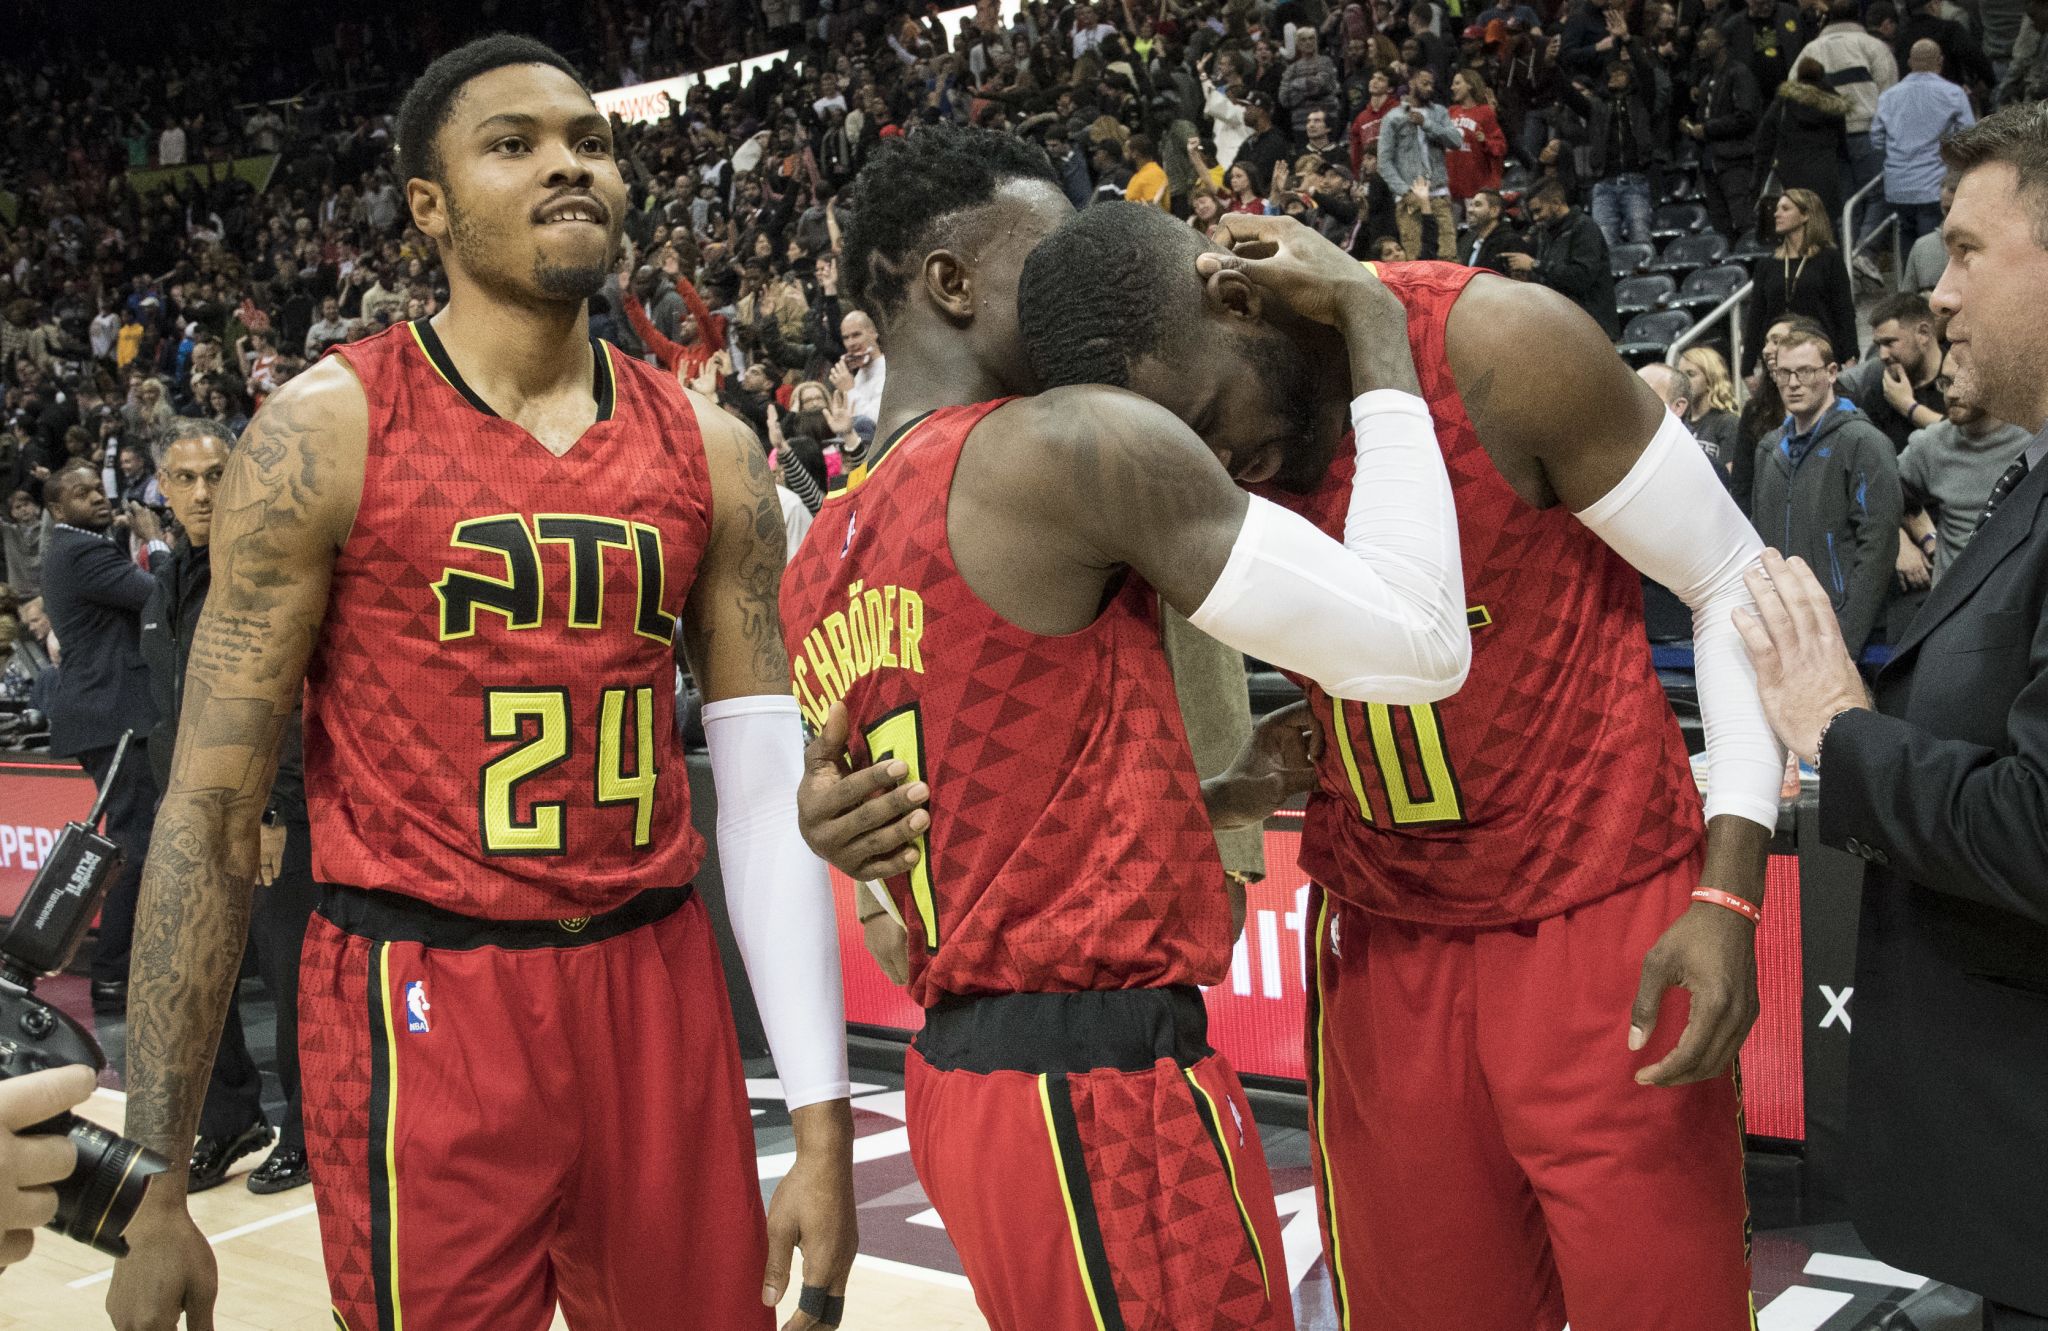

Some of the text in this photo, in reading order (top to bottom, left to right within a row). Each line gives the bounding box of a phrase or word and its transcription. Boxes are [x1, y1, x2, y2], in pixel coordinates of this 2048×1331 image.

[430, 513, 677, 647] ATL
[480, 683, 659, 857] 24
[35, 888, 64, 930] Transceiver
[409, 1022, 426, 1032] NBA
